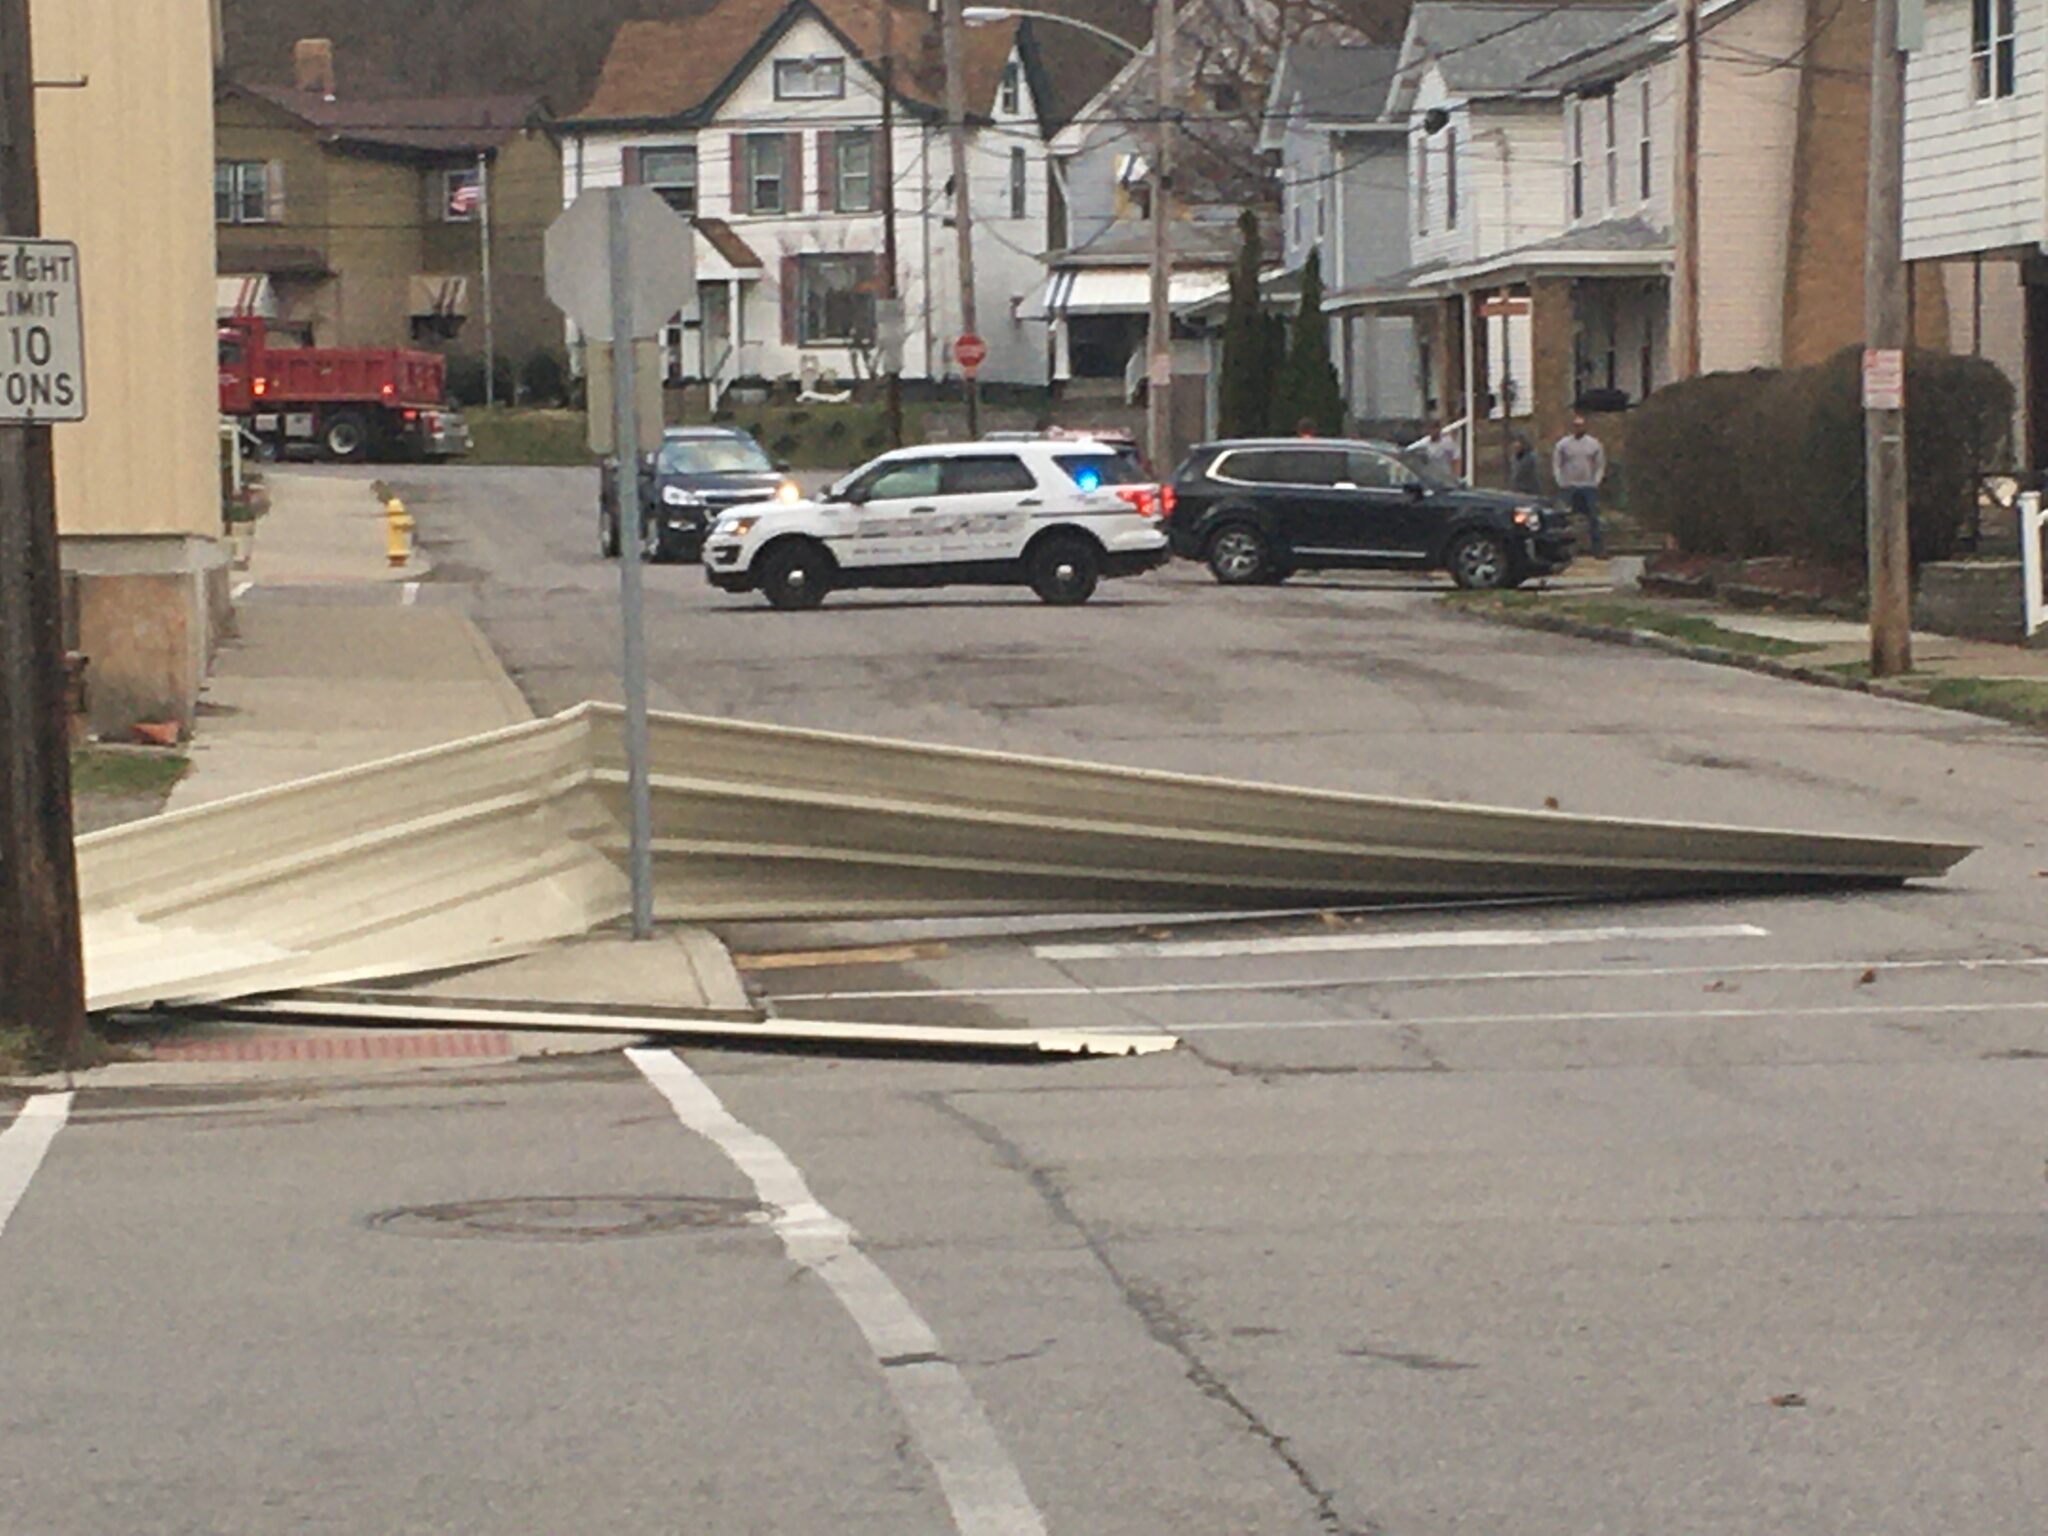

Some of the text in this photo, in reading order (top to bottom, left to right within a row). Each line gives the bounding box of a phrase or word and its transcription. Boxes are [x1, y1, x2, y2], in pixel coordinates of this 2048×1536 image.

[0, 255, 71, 282] EIGHT
[9, 326, 51, 366] 10
[0, 372, 74, 406] ONS
